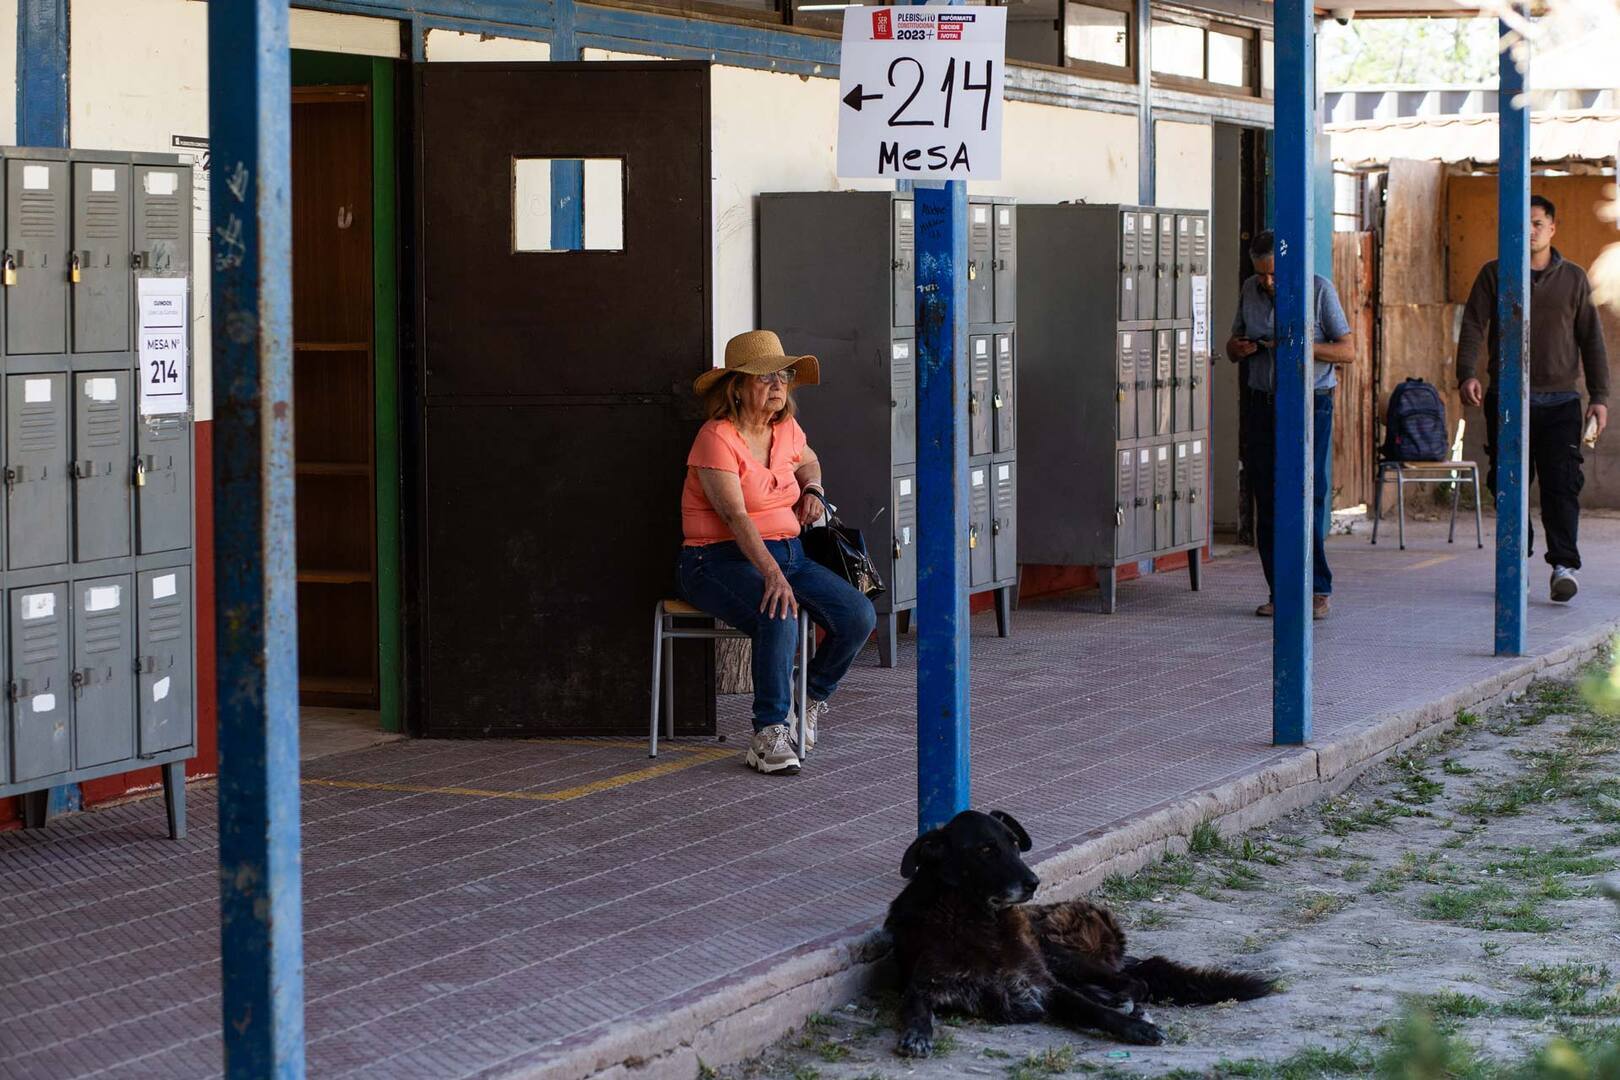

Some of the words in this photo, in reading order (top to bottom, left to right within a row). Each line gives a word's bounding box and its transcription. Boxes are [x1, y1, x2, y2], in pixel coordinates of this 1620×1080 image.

[897, 13, 936, 22] PLEBISCITO
[887, 56, 993, 131] 214
[147, 339, 169, 350] MESA
[150, 360, 178, 384] 214
